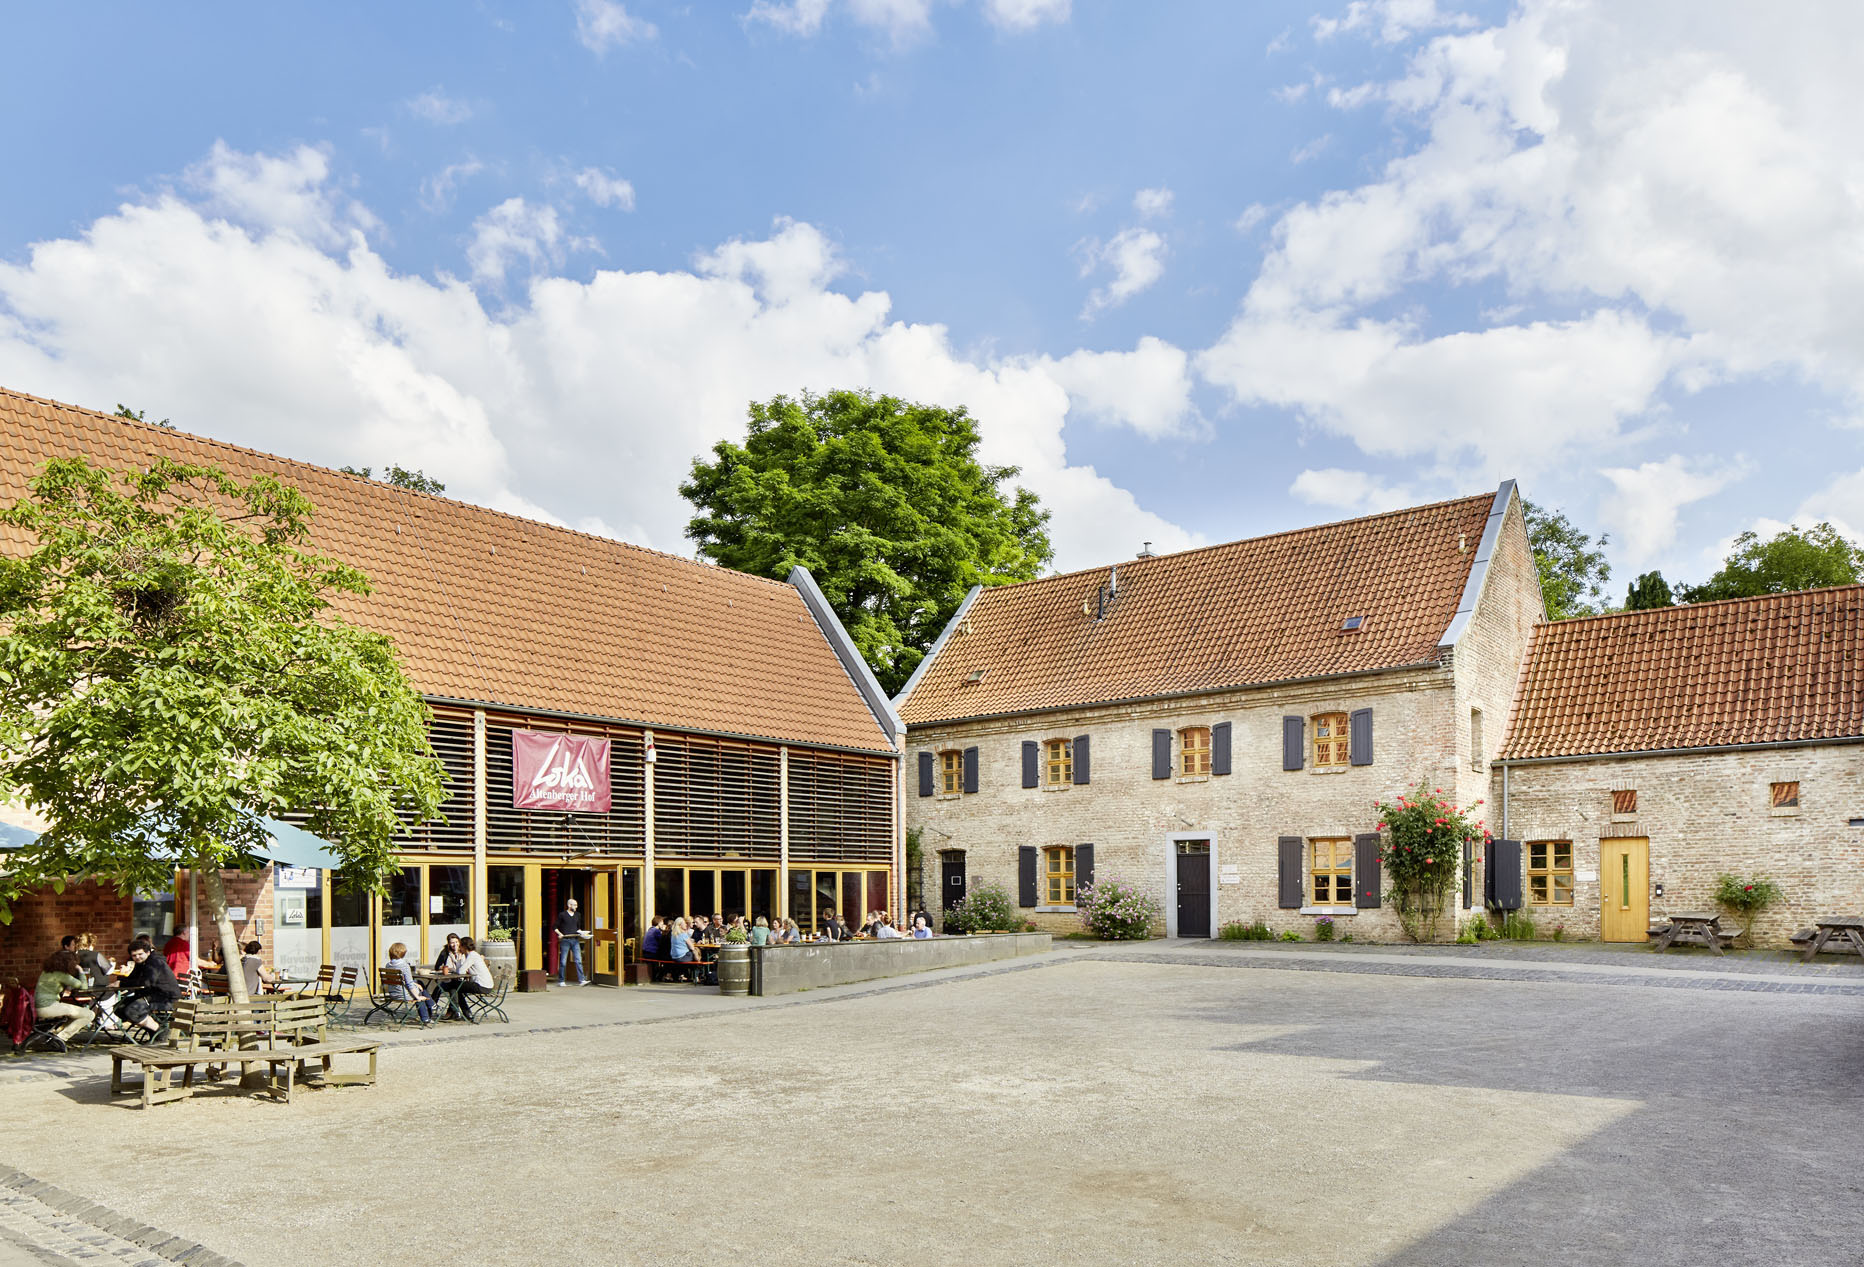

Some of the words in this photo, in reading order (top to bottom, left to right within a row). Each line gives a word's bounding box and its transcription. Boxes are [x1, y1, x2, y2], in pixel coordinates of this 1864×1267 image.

[529, 788, 578, 802] Altenberger
[580, 790, 595, 802] Hof
[280, 954, 317, 964] Havana
[333, 951, 366, 961] Havana
[288, 965, 309, 974] Club
